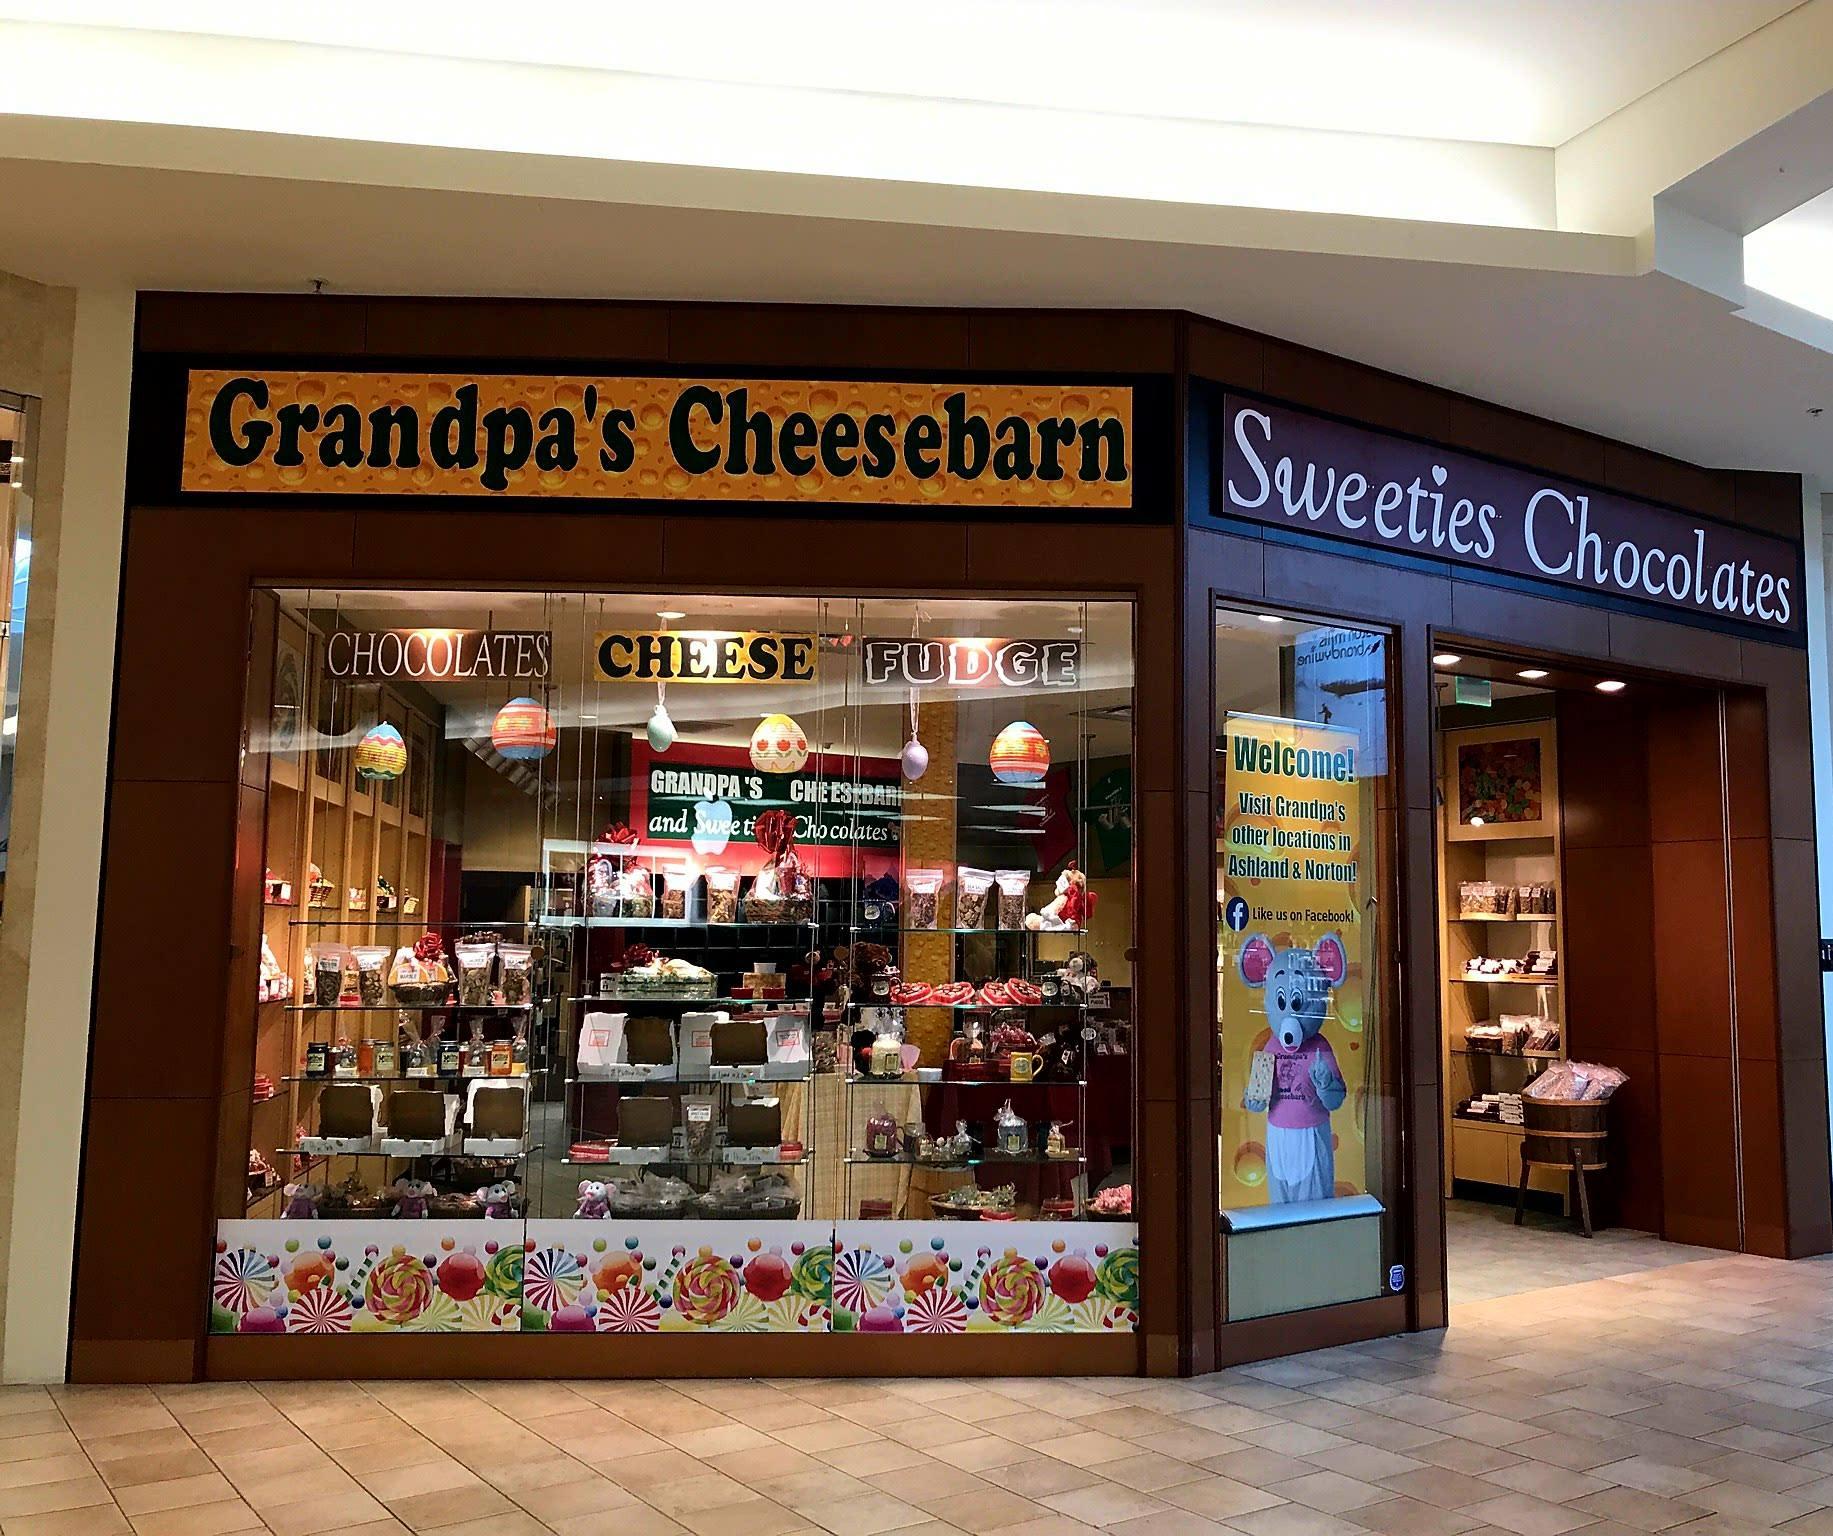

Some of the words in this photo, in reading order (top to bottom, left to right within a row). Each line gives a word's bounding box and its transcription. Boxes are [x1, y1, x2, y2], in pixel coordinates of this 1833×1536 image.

[208, 377, 636, 491] Grandpa's
[668, 384, 1129, 482] Cheesebarn
[1228, 408, 1496, 559] Sweeties
[1524, 488, 1790, 624] Chocolates
[328, 632, 549, 678] CHOCOLATES
[598, 634, 815, 681] CHEESE
[865, 641, 1078, 686] FUDGE
[1233, 735, 1355, 783] Welcome!
[649, 808, 688, 833] and
[1239, 792, 1271, 816] Visit
[1275, 796, 1346, 822] Grandpa's
[1232, 825, 1269, 846] other
[1273, 827, 1335, 850] locations
[1338, 831, 1351, 851] in
[1228, 854, 1289, 879] Ashland
[1292, 862, 1301, 879] &
[1305, 859, 1357, 882] Norton!
[1252, 907, 1273, 921] Like
[1276, 909, 1288, 921] us
[1290, 909, 1302, 921] on
[1305, 909, 1354, 923] Facebook!
